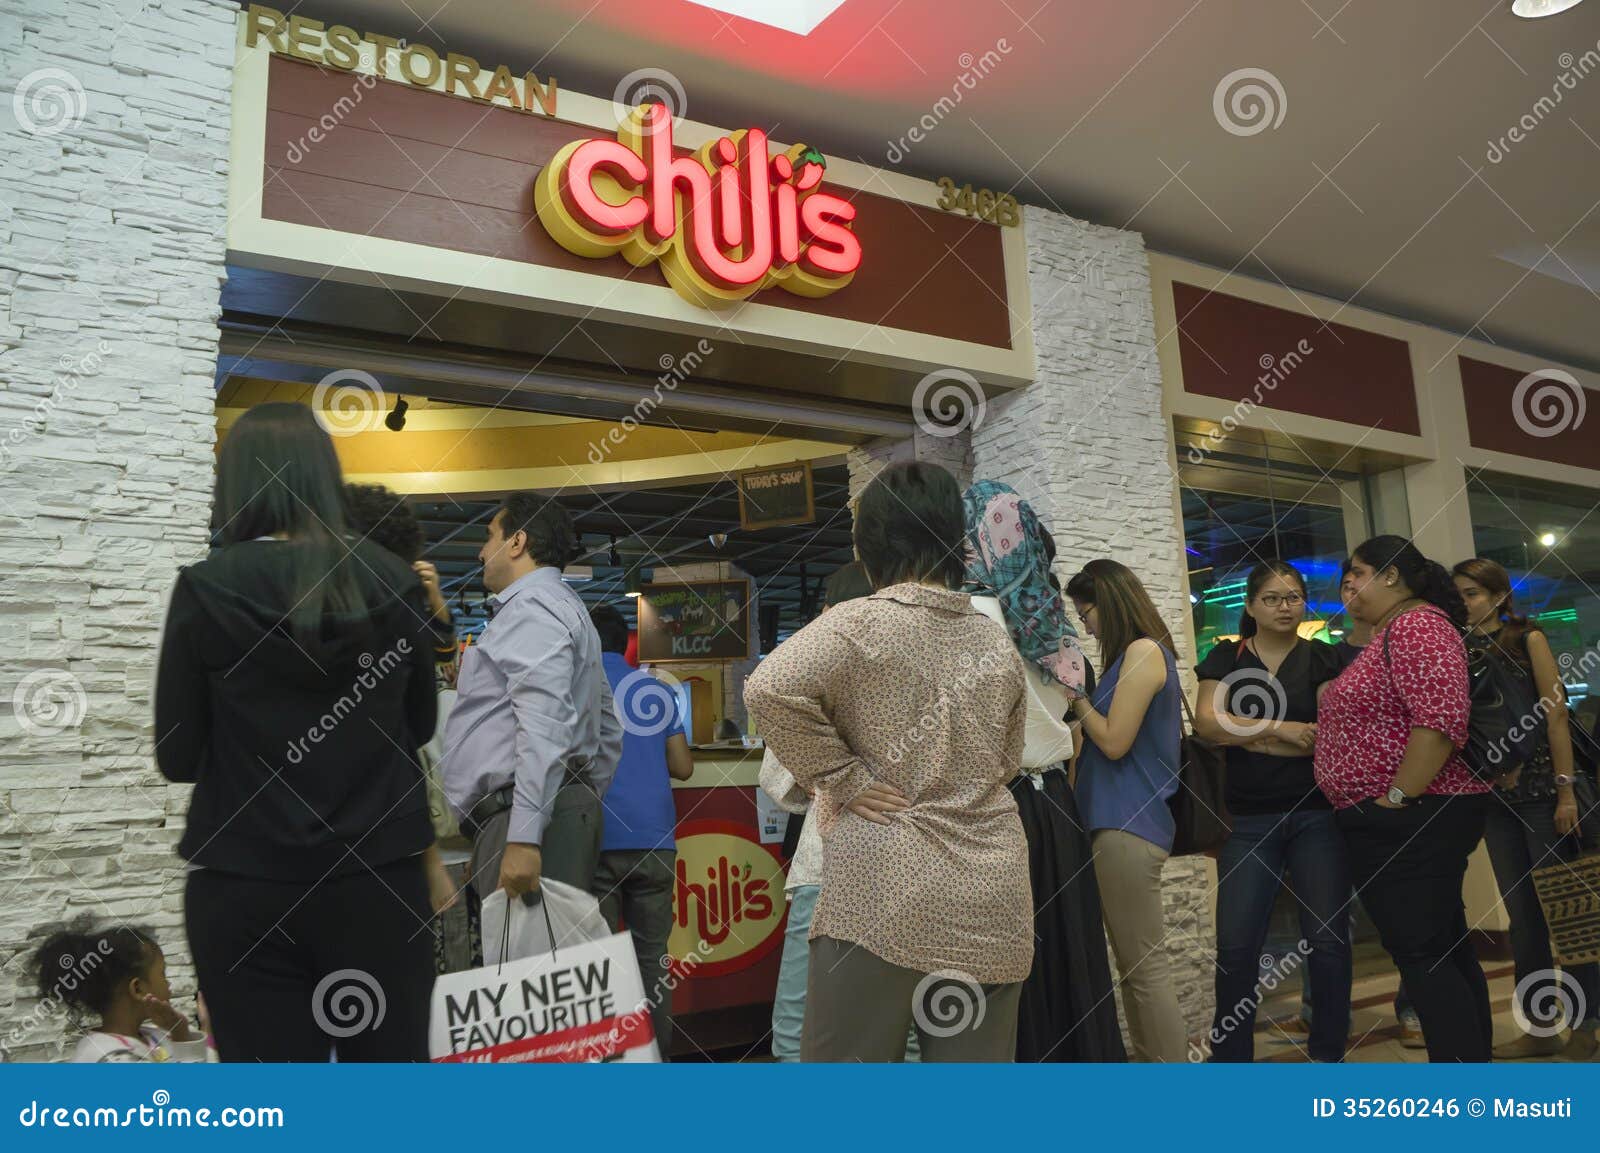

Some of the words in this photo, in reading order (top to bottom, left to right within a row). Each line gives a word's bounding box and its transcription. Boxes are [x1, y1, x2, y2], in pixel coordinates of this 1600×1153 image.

[246, 3, 558, 117] RESTORAN
[561, 102, 863, 285] chili's
[936, 176, 1020, 227] 346B
[671, 635, 713, 656] KLCC
[672, 856, 773, 946] hili's
[445, 983, 508, 1028] MY
[521, 958, 610, 1011] NEW
[449, 993, 617, 1055] FAVOURITE
